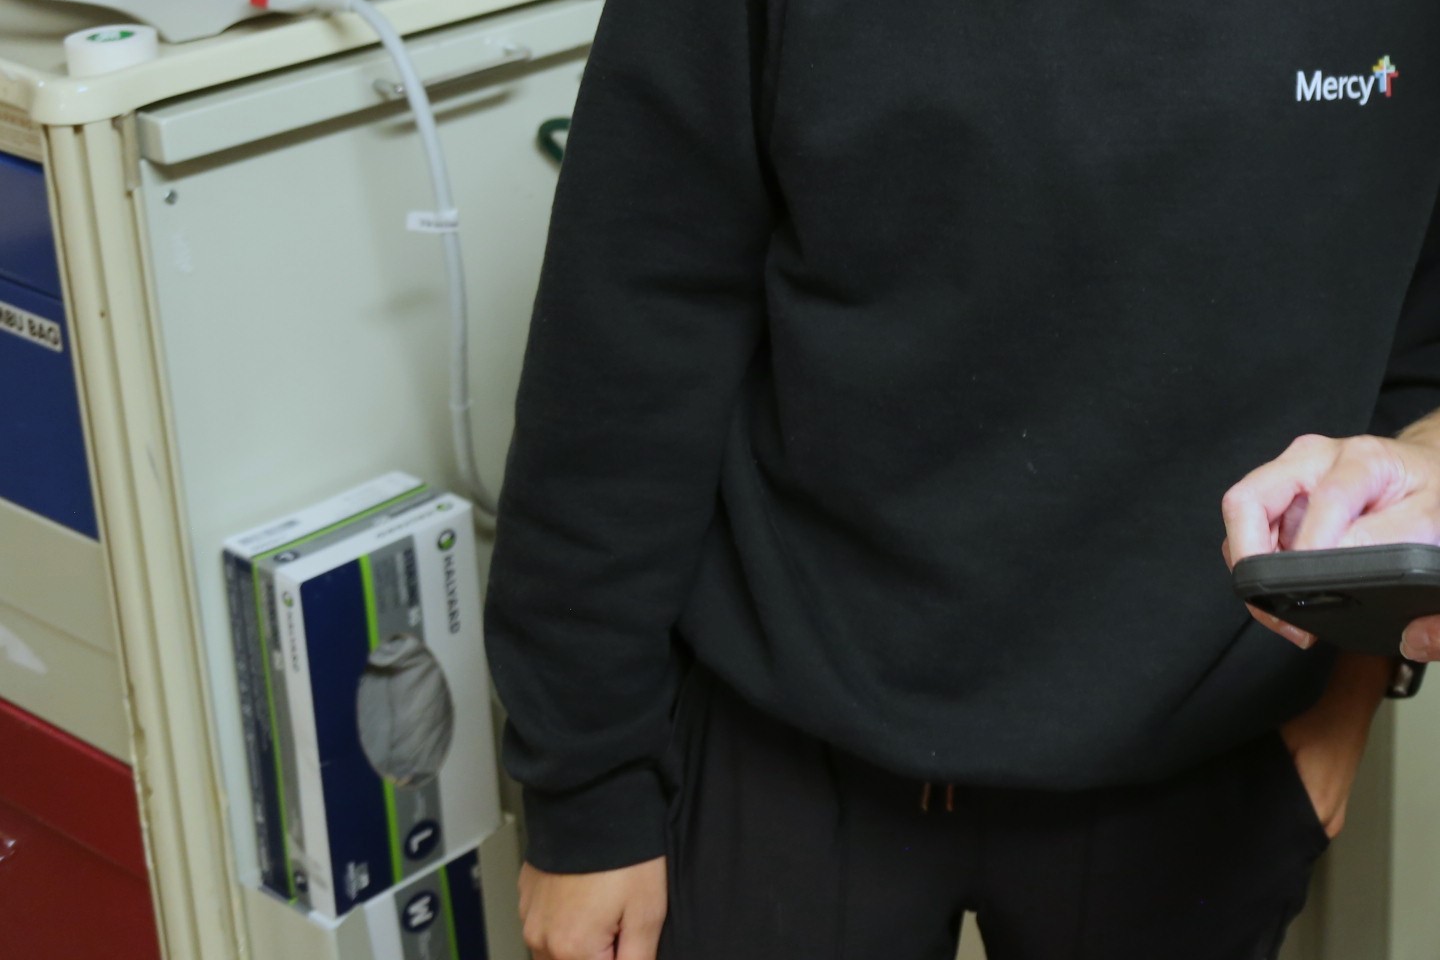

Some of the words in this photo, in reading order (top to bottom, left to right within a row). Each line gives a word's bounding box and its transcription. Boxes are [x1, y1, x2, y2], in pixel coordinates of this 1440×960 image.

[1296, 69, 1375, 106] Mercy
[0, 307, 25, 332] BU
[27, 318, 59, 346] BAG
[444, 553, 461, 635] HALYARD
[410, 827, 434, 855] L
